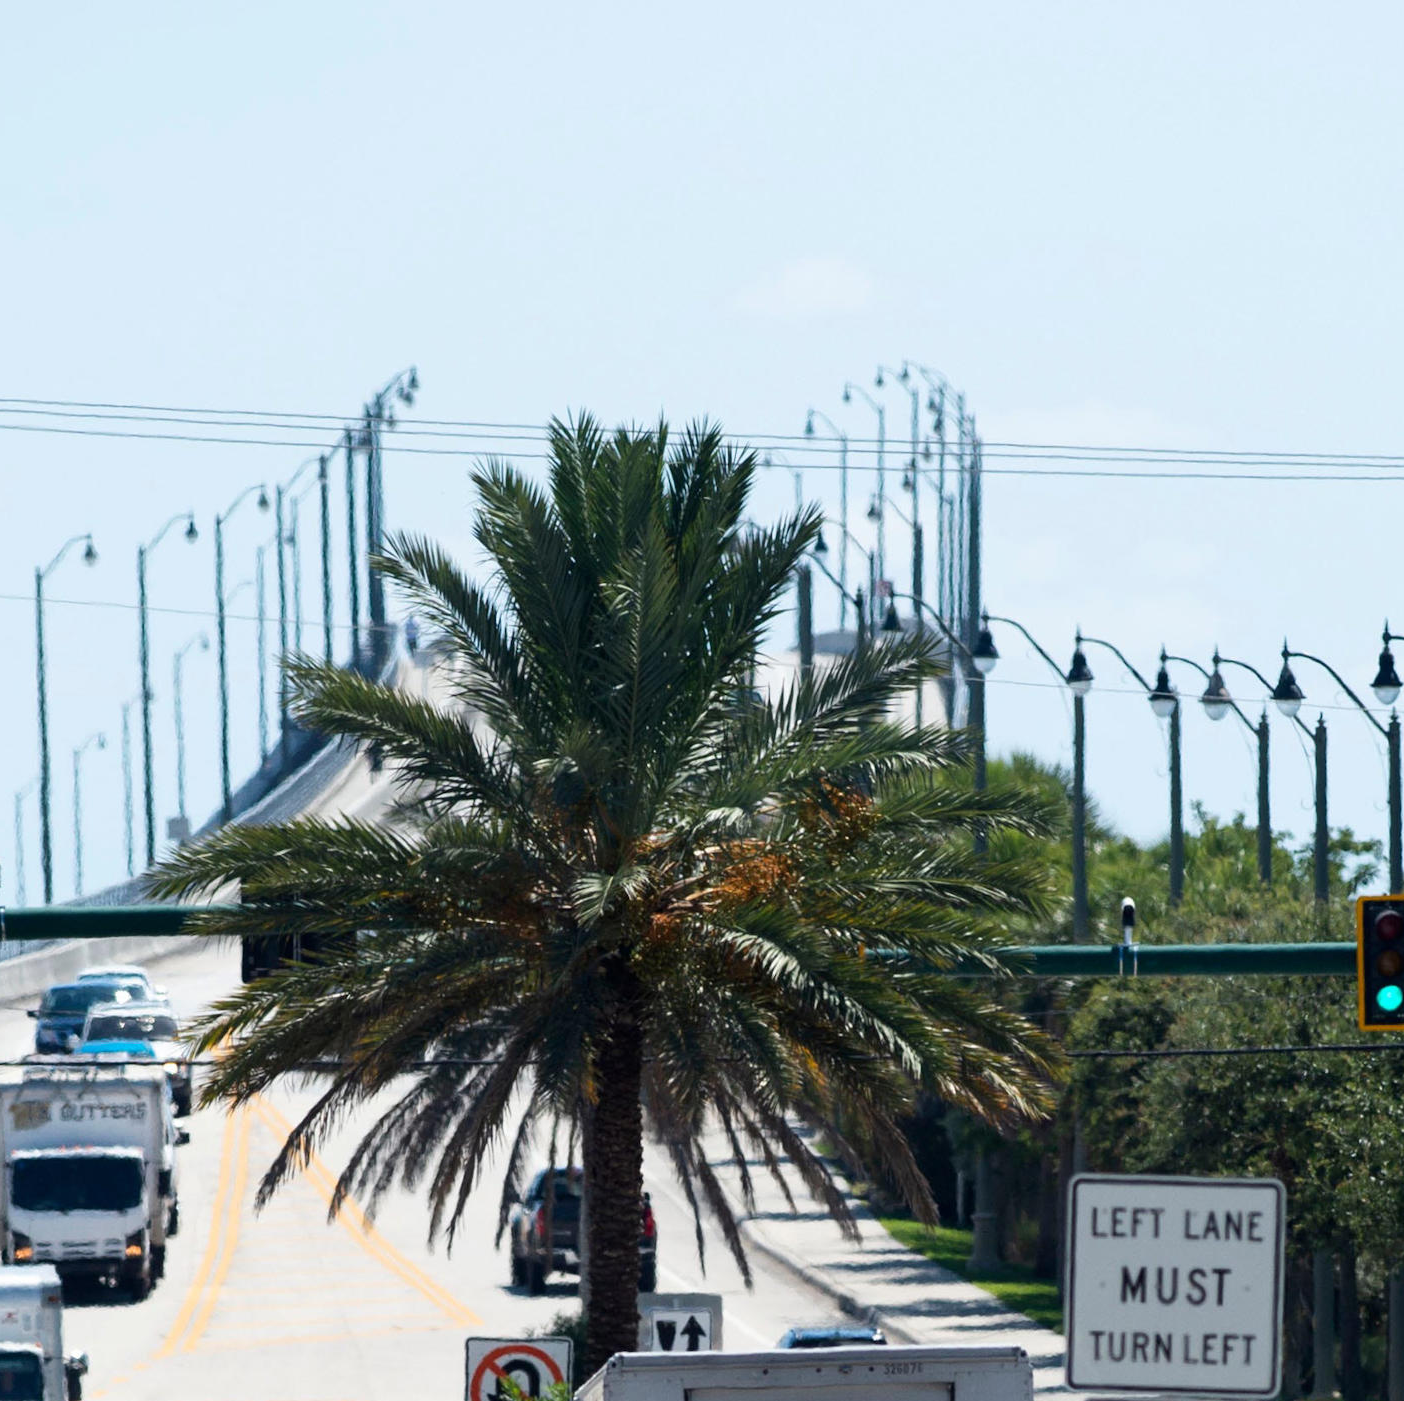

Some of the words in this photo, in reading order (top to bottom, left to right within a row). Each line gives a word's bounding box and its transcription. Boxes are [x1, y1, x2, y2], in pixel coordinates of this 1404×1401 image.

[1091, 1206, 1165, 1239] LEFT
[1184, 1209, 1264, 1242] LANE
[1120, 1266, 1232, 1307] MUST
[1089, 1330, 1173, 1363] TURN
[1183, 1333, 1257, 1366] LEFT
